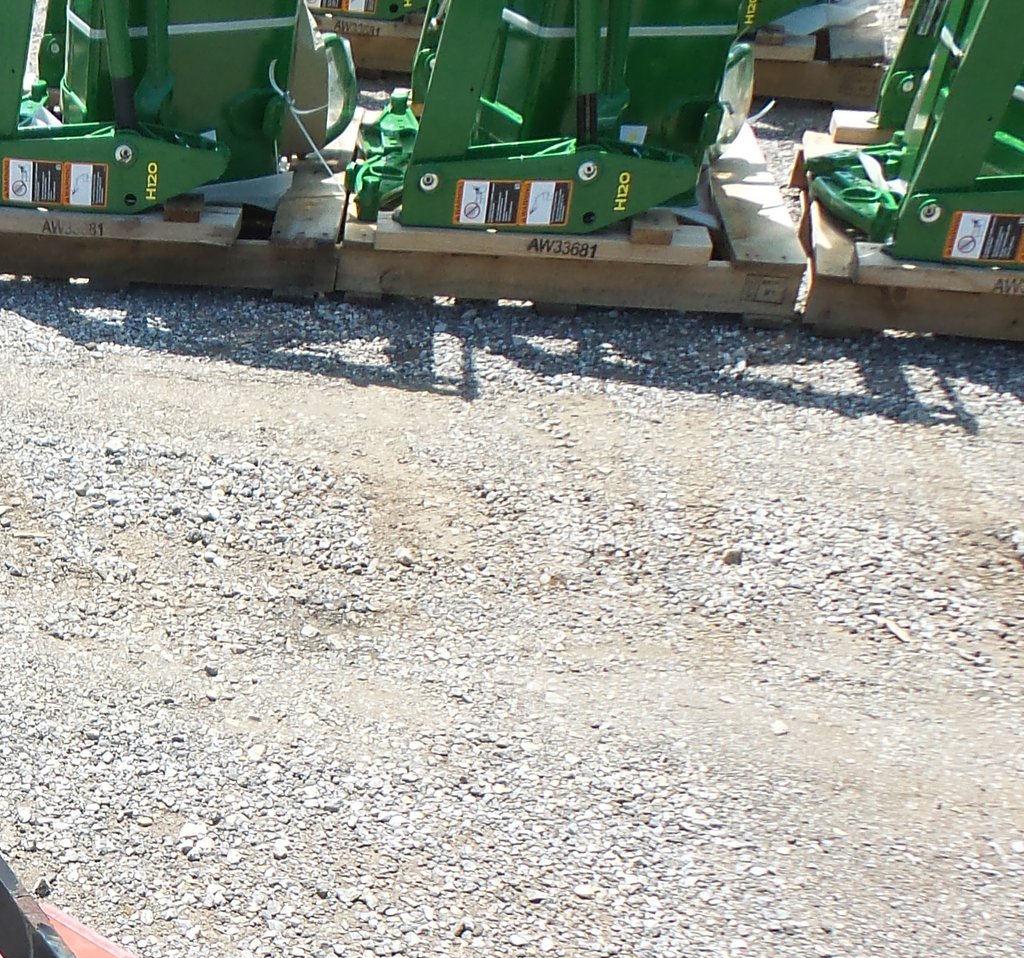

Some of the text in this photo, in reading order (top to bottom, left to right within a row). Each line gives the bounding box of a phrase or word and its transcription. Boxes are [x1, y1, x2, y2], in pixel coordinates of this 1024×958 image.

[146, 162, 157, 199] H120
[613, 172, 631, 211] H120
[527, 237, 598, 258] AW33681
